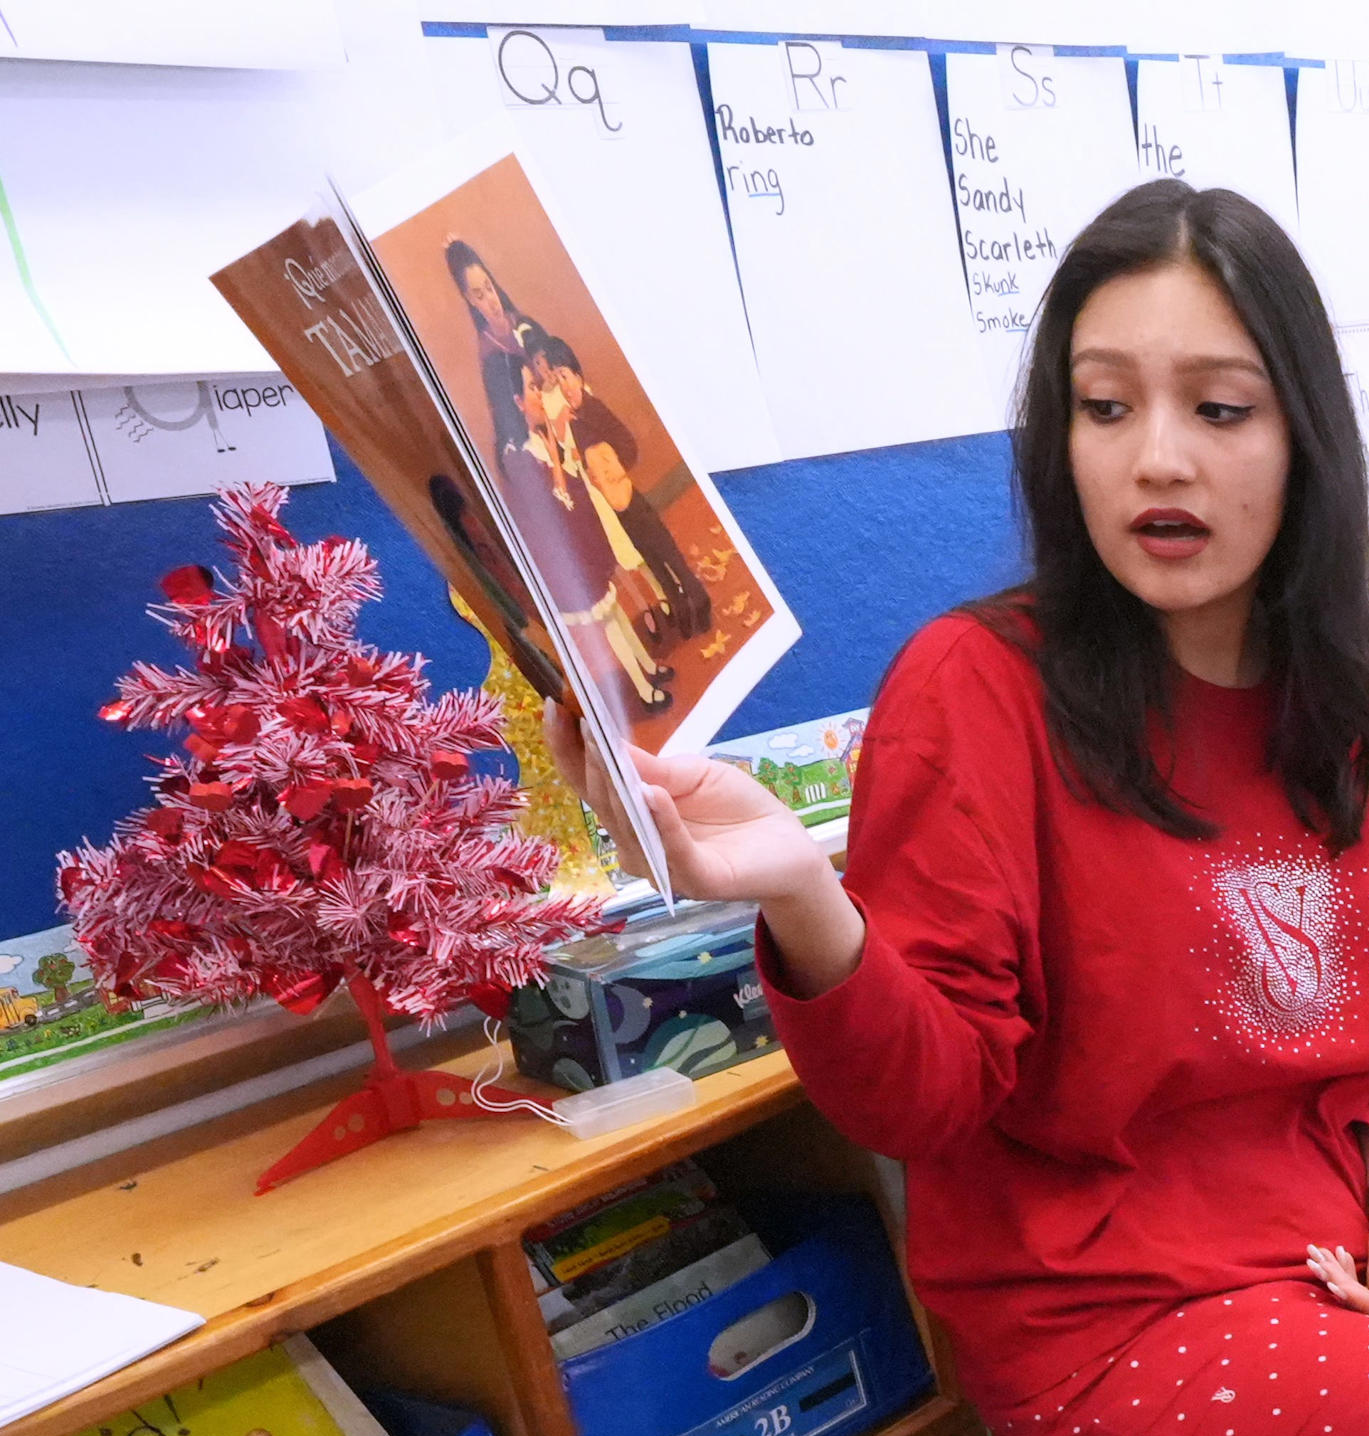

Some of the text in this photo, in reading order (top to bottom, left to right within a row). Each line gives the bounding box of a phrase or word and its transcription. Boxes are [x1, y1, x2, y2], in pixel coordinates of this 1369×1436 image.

[498, 30, 622, 132] Qq
[786, 42, 846, 110] Rr
[1011, 46, 1056, 107] Ss
[716, 104, 815, 147] Roberto
[954, 117, 1000, 163] She
[1141, 122, 1185, 178] the
[725, 160, 785, 215] ring
[957, 176, 1026, 224] Sandy
[964, 229, 1057, 261] Scarleth
[973, 271, 1019, 295] Skunk
[976, 311, 1030, 334] Smoke
[0, 394, 40, 437] lly
[605, 1318, 650, 1342] The
